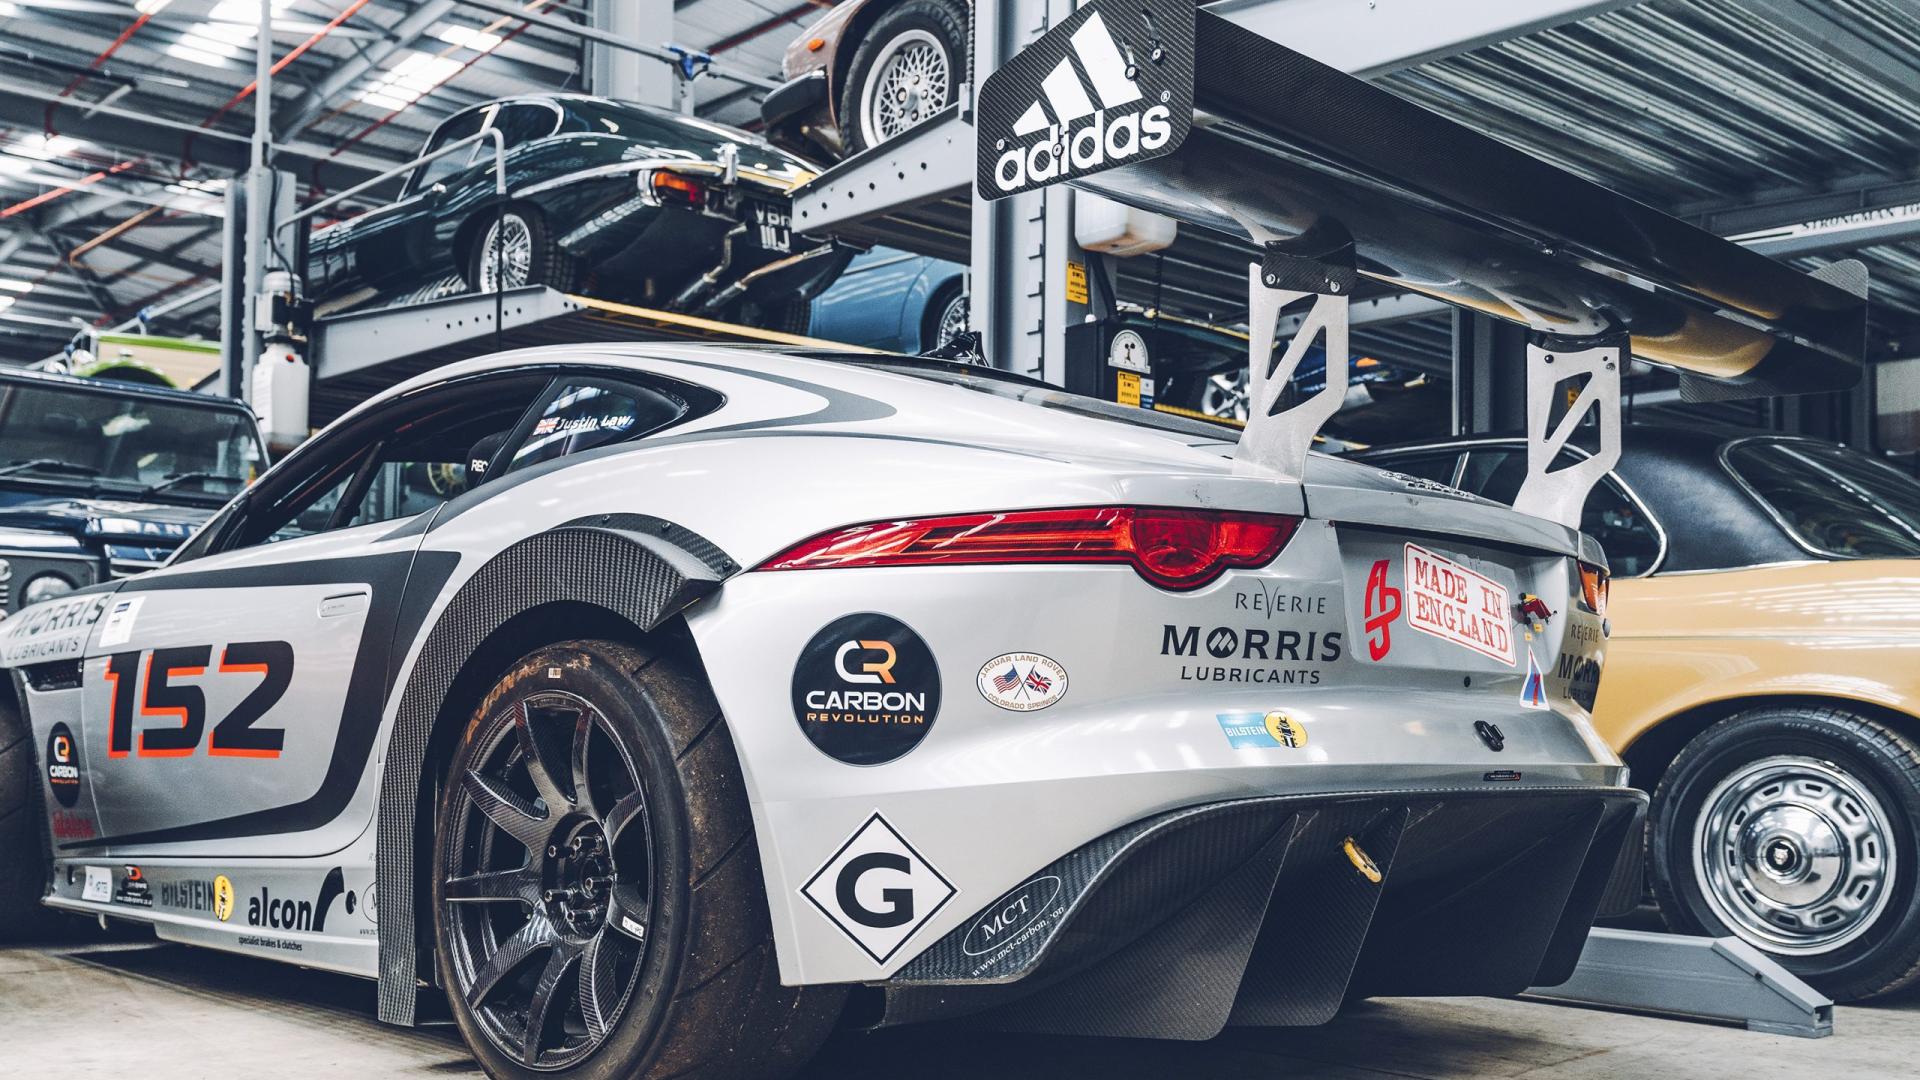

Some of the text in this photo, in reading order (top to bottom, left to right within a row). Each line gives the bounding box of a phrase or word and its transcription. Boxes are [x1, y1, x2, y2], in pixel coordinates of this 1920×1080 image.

[994, 104, 1172, 192] adidas
[556, 415, 599, 431] Justin
[1235, 578, 1327, 620] REVERIE
[1414, 556, 1504, 621] MADE IN
[8, 593, 111, 639] MORRIS
[1414, 590, 1509, 654] ENGLAND
[6, 636, 81, 661] LUBRICANTS
[1160, 624, 1343, 662] MORRIS
[981, 655, 1065, 681] JAGUAR LAND ROVER
[1181, 665, 1320, 685] LUBRICANTS
[104, 640, 295, 759] 152
[806, 690, 925, 711] CARBON
[987, 692, 1058, 710] COLORADO SPRINGS
[806, 712, 924, 724] REVOLUTION
[1224, 725, 1267, 737] BILSTEIN
[49, 765, 79, 778] CARBON
[161, 879, 215, 912] BILSTEIN
[835, 852, 915, 929] G
[248, 886, 312, 932] alcon
[982, 894, 1029, 942] MCT
[260, 937, 276, 949] brakes
[281, 940, 303, 951] clutches
